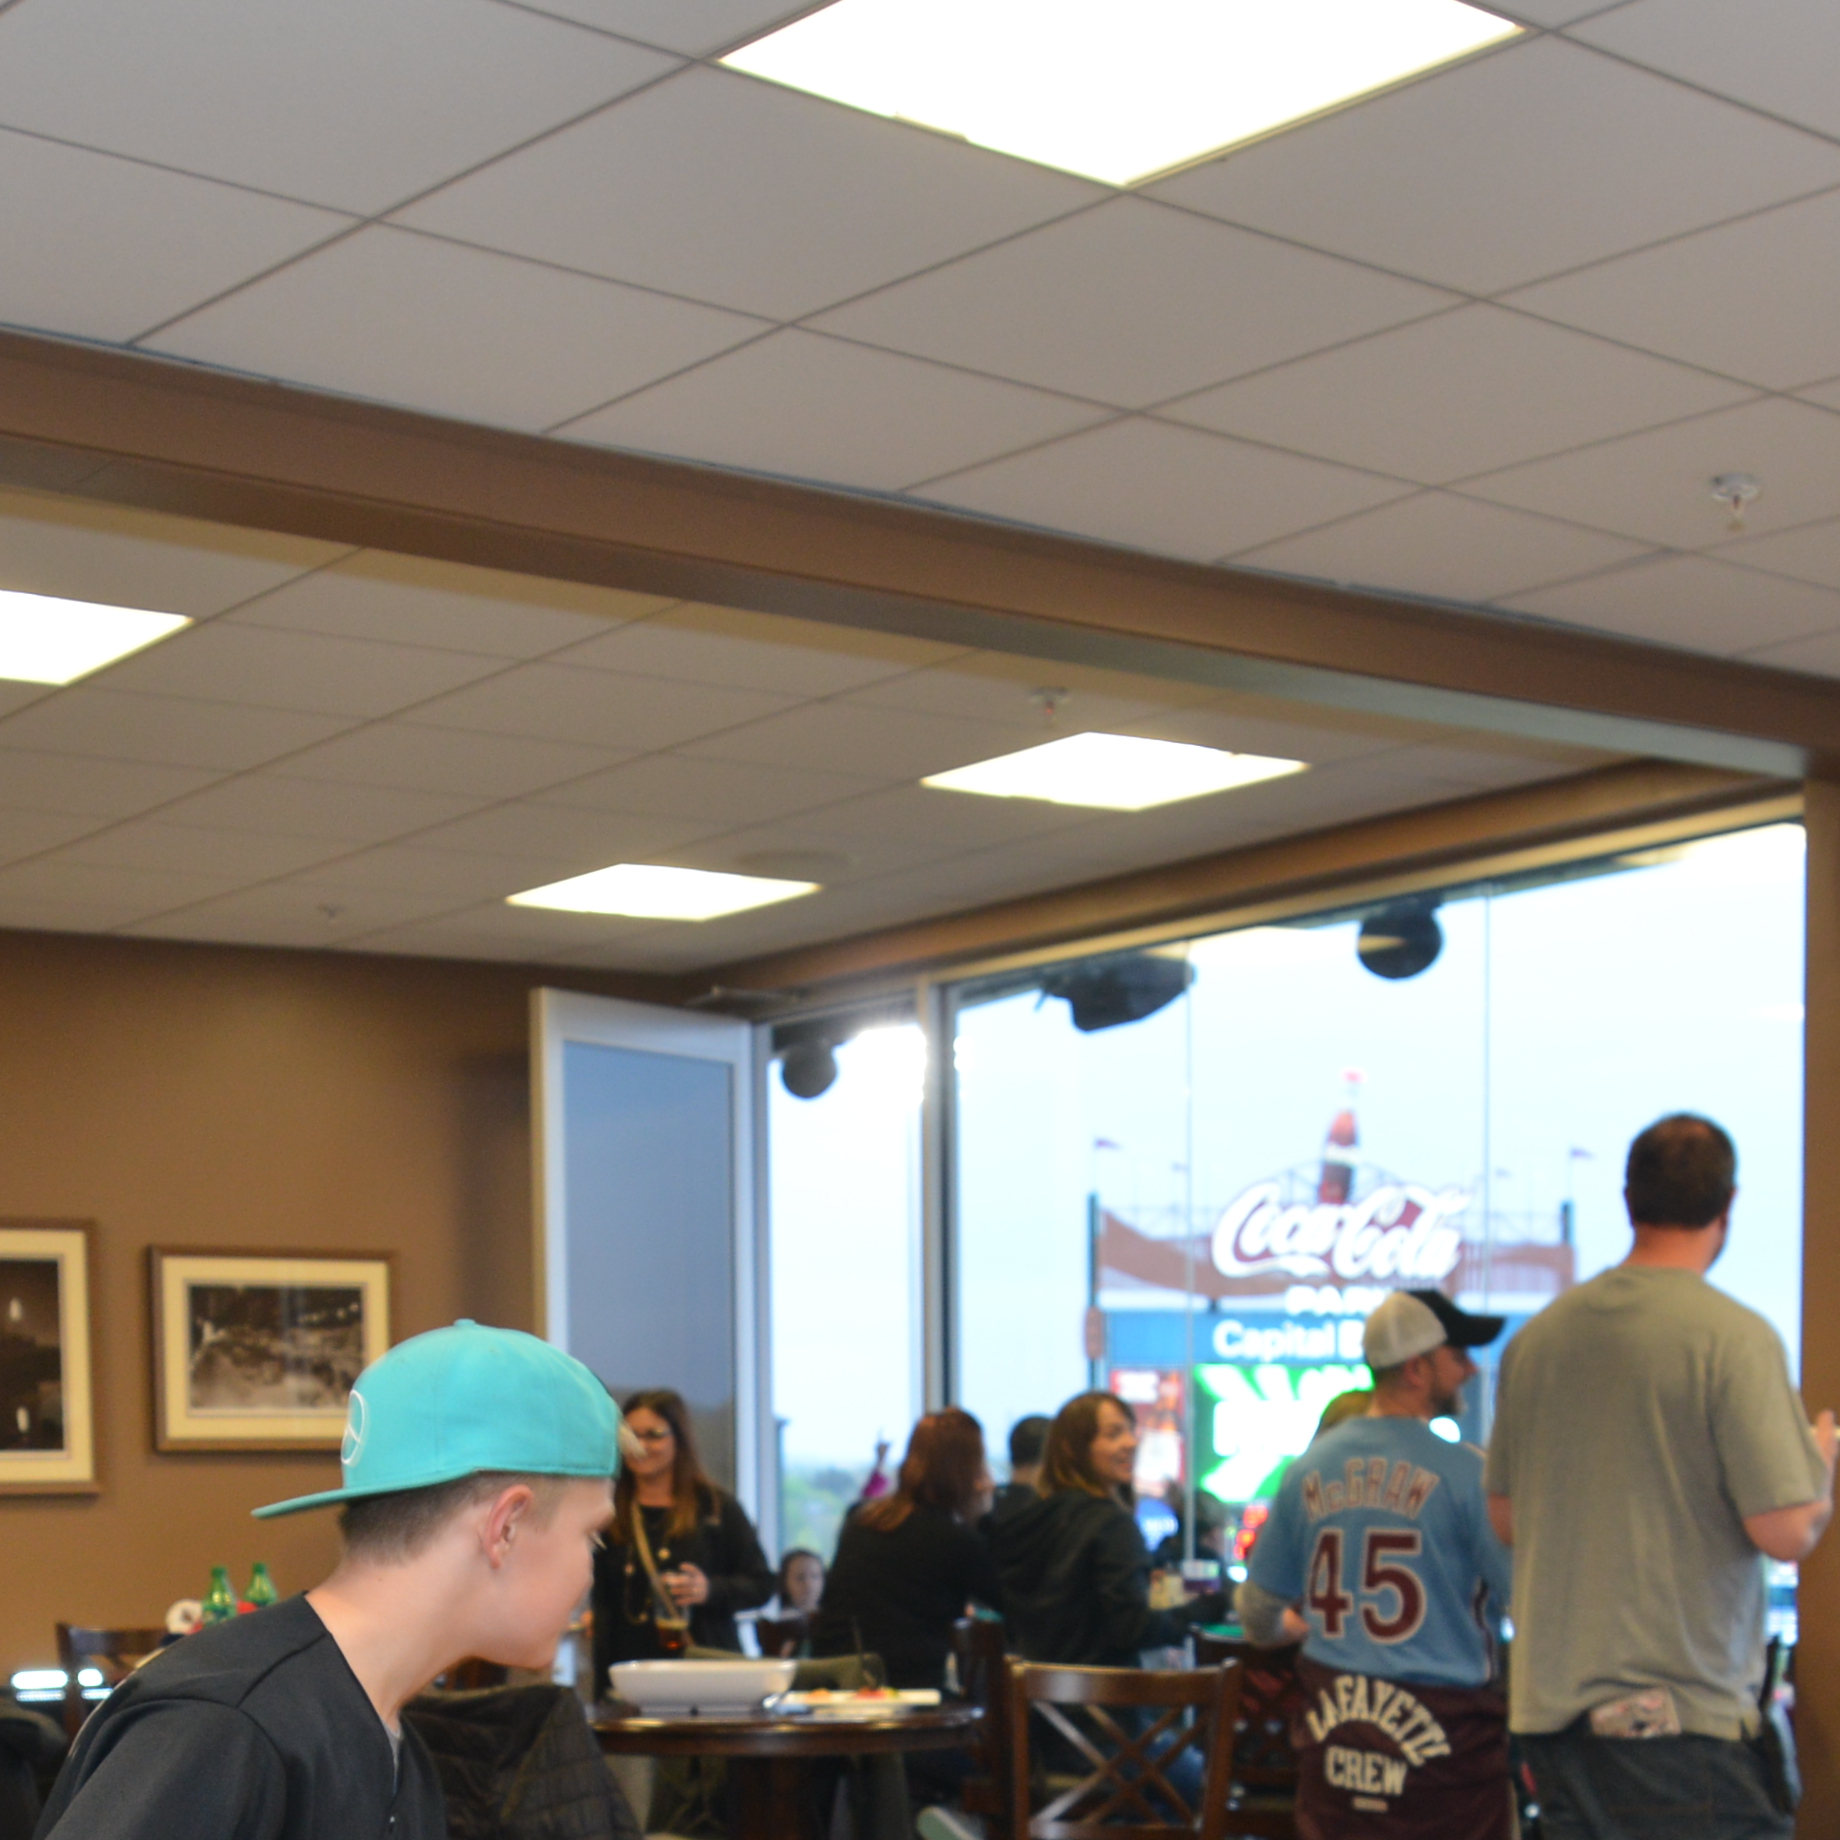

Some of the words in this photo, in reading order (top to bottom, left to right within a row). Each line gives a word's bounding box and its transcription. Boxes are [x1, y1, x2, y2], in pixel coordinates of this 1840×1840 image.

[1212, 1182, 1470, 1279] Coca-Cola
[1213, 1318, 1336, 1362] Capital
[1301, 1457, 1441, 1521] McGRAW
[1308, 1527, 1428, 1645] 45
[1325, 1745, 1407, 1796] CREW
